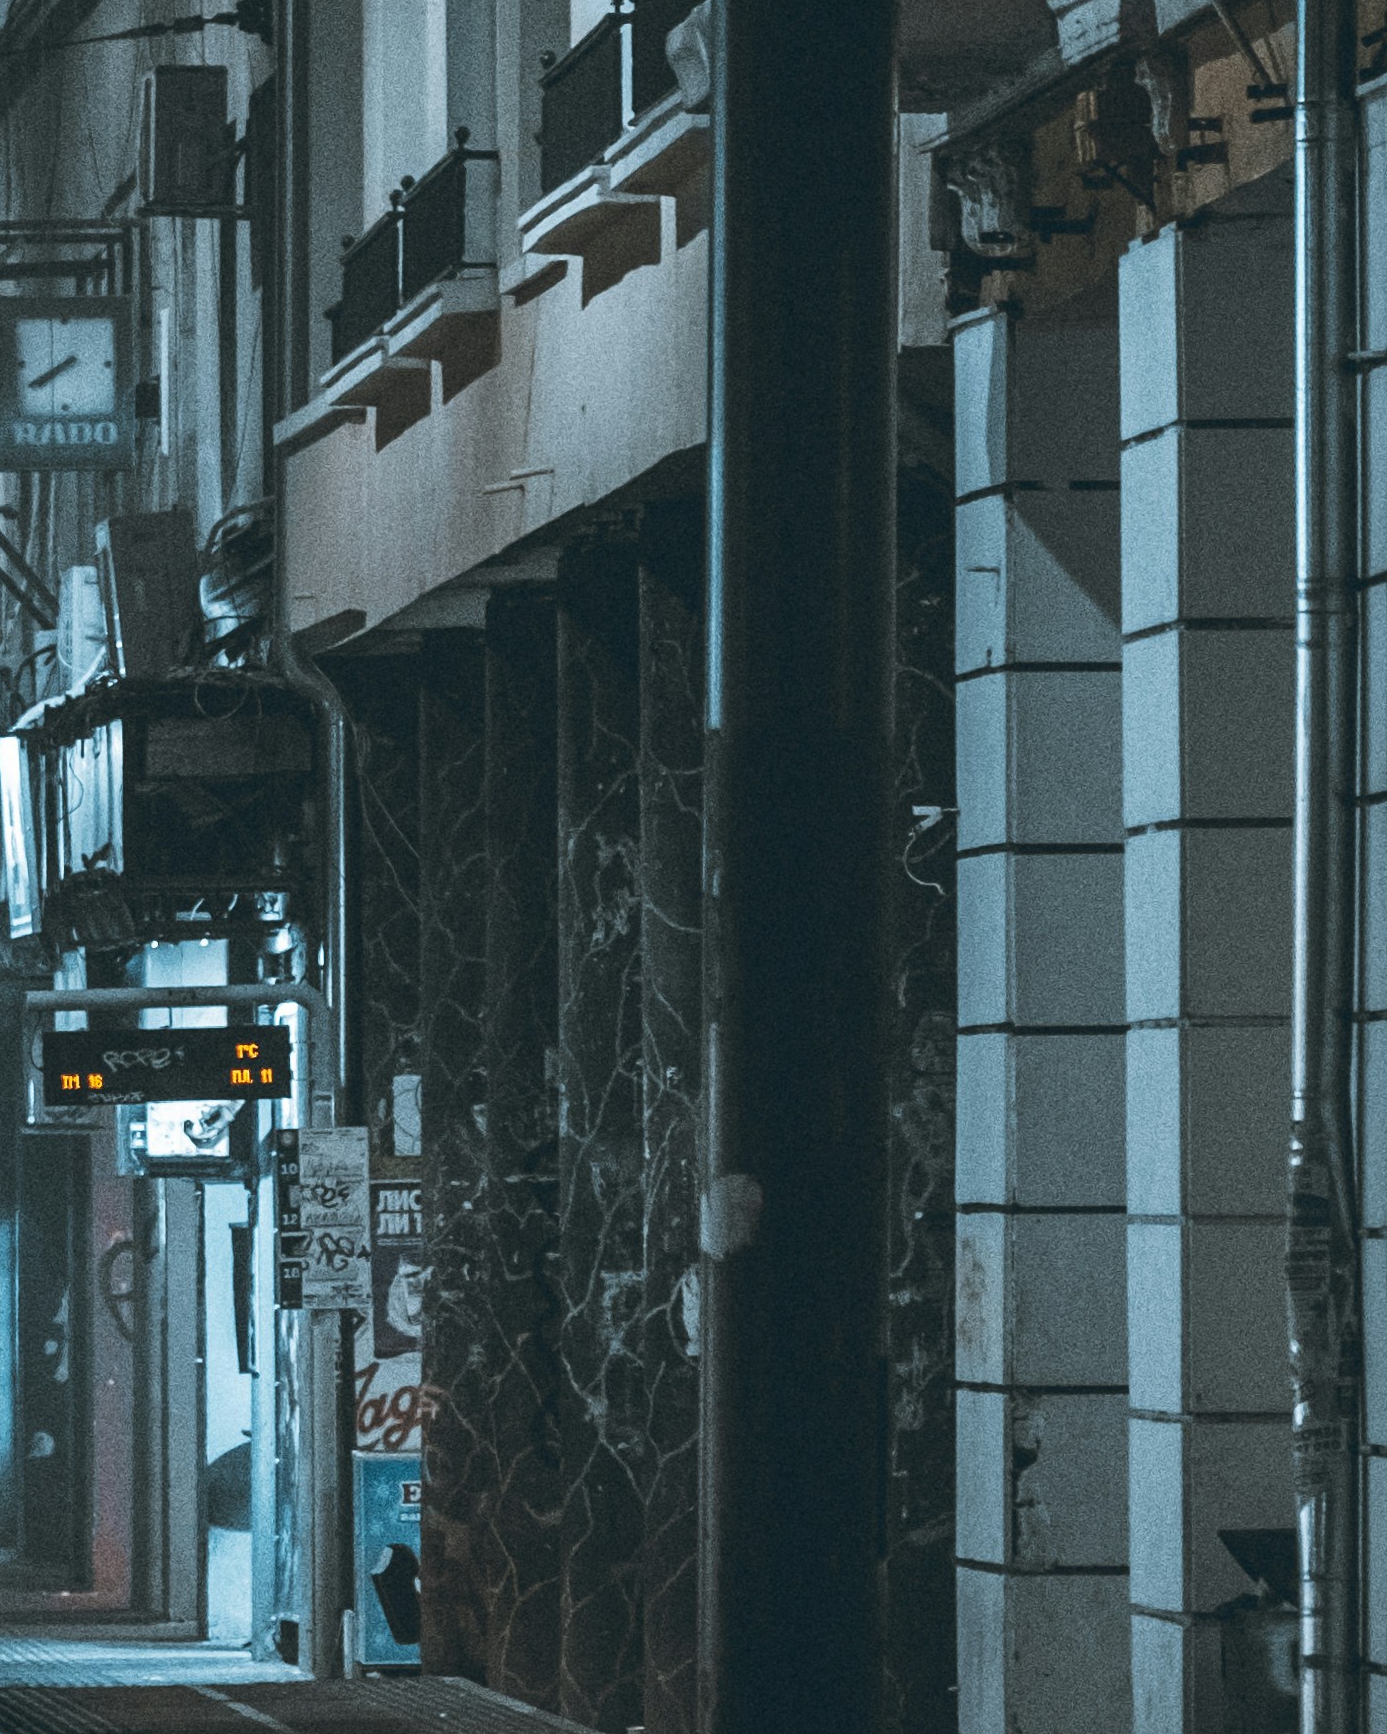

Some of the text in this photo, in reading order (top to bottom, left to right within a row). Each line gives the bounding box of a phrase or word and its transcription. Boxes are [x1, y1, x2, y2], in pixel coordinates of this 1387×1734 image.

[14, 421, 119, 445] RADO
[281, 1163, 299, 1176] 10
[282, 1213, 299, 1226] 12
